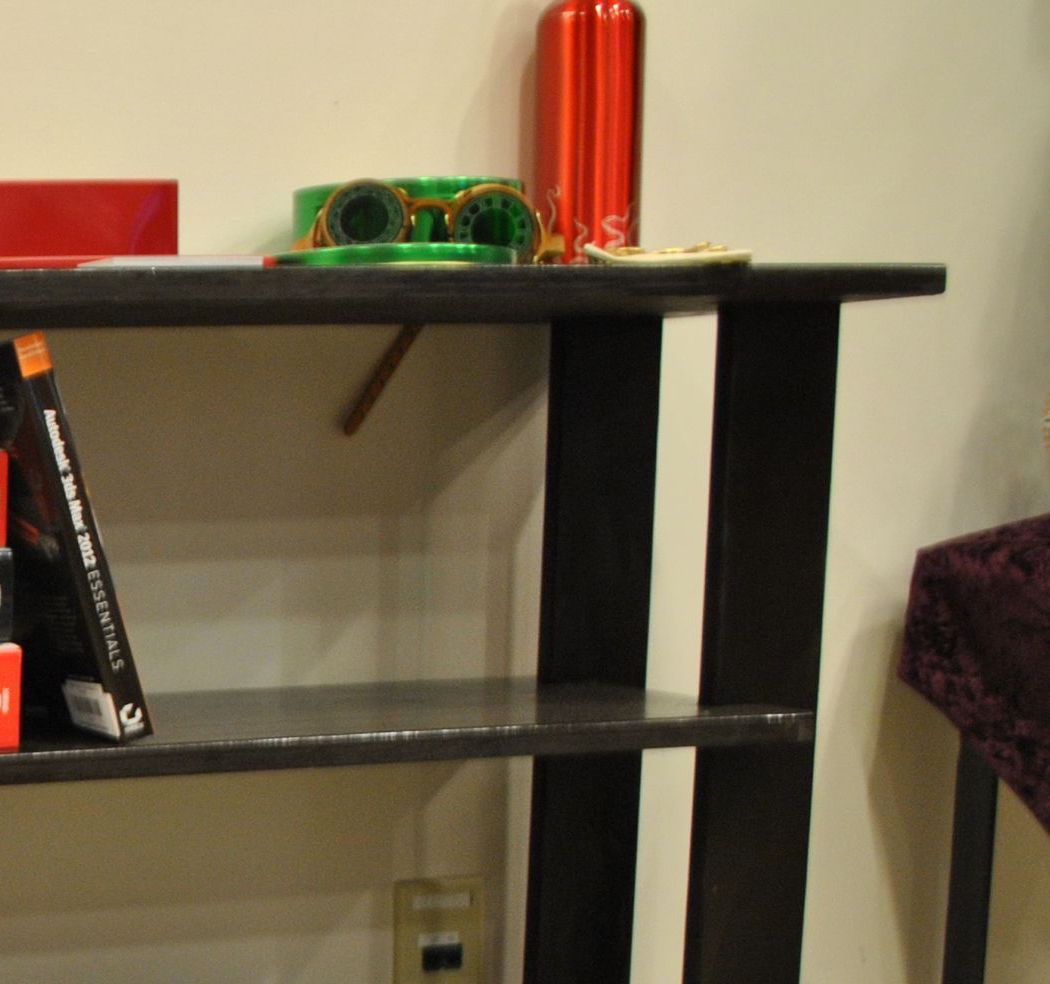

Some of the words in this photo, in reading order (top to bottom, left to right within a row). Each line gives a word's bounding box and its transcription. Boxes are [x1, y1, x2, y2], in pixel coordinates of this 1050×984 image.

[43, 409, 71, 474] Autodesk
[61, 473, 77, 500] 3ds
[69, 500, 85, 531] Max
[77, 532, 97, 570] 2012
[87, 569, 125, 673] ESSENTIALS
